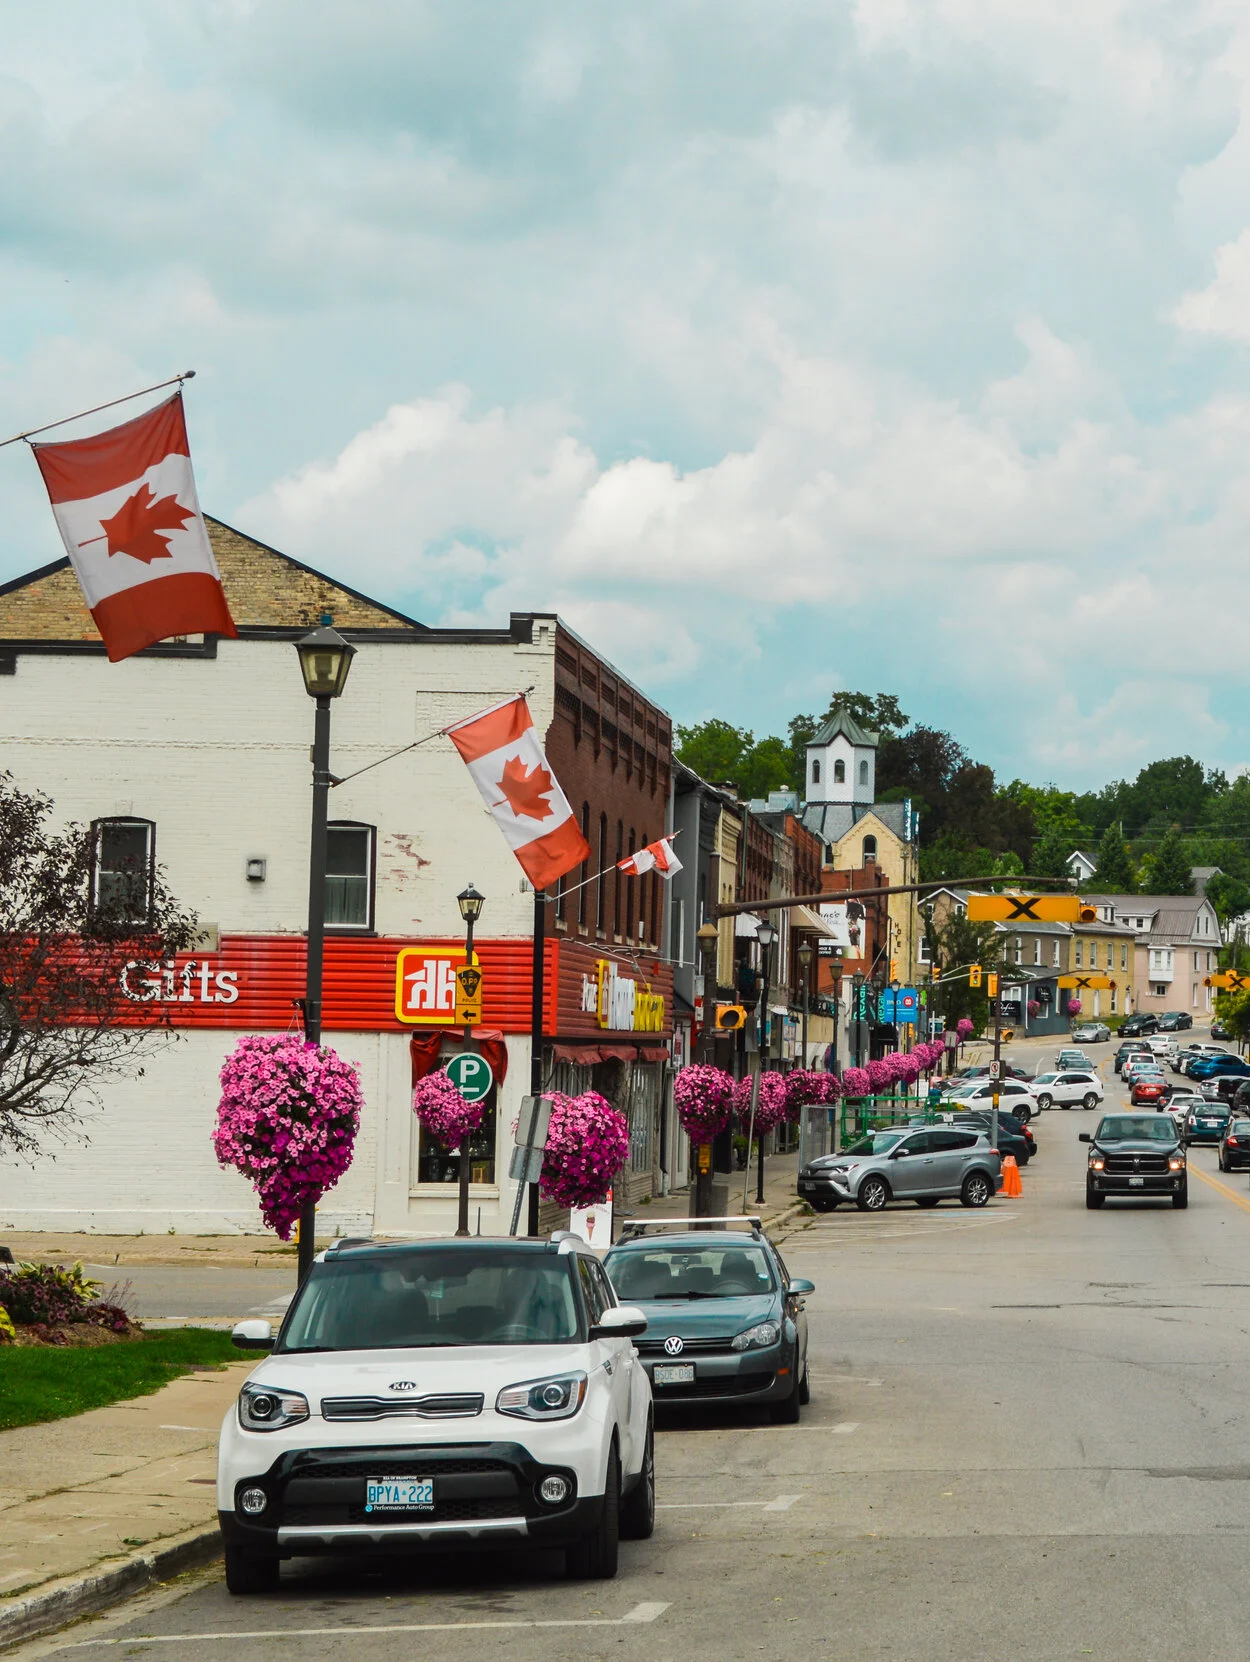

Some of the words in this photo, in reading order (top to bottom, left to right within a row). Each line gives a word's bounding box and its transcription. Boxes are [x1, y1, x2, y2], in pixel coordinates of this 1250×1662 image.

[894, 922, 902, 954] HOTEL
[119, 960, 239, 1003] Gifts
[460, 1059, 480, 1083] P
[392, 1382, 414, 1390] KIA
[418, 1504, 435, 1512] Group
